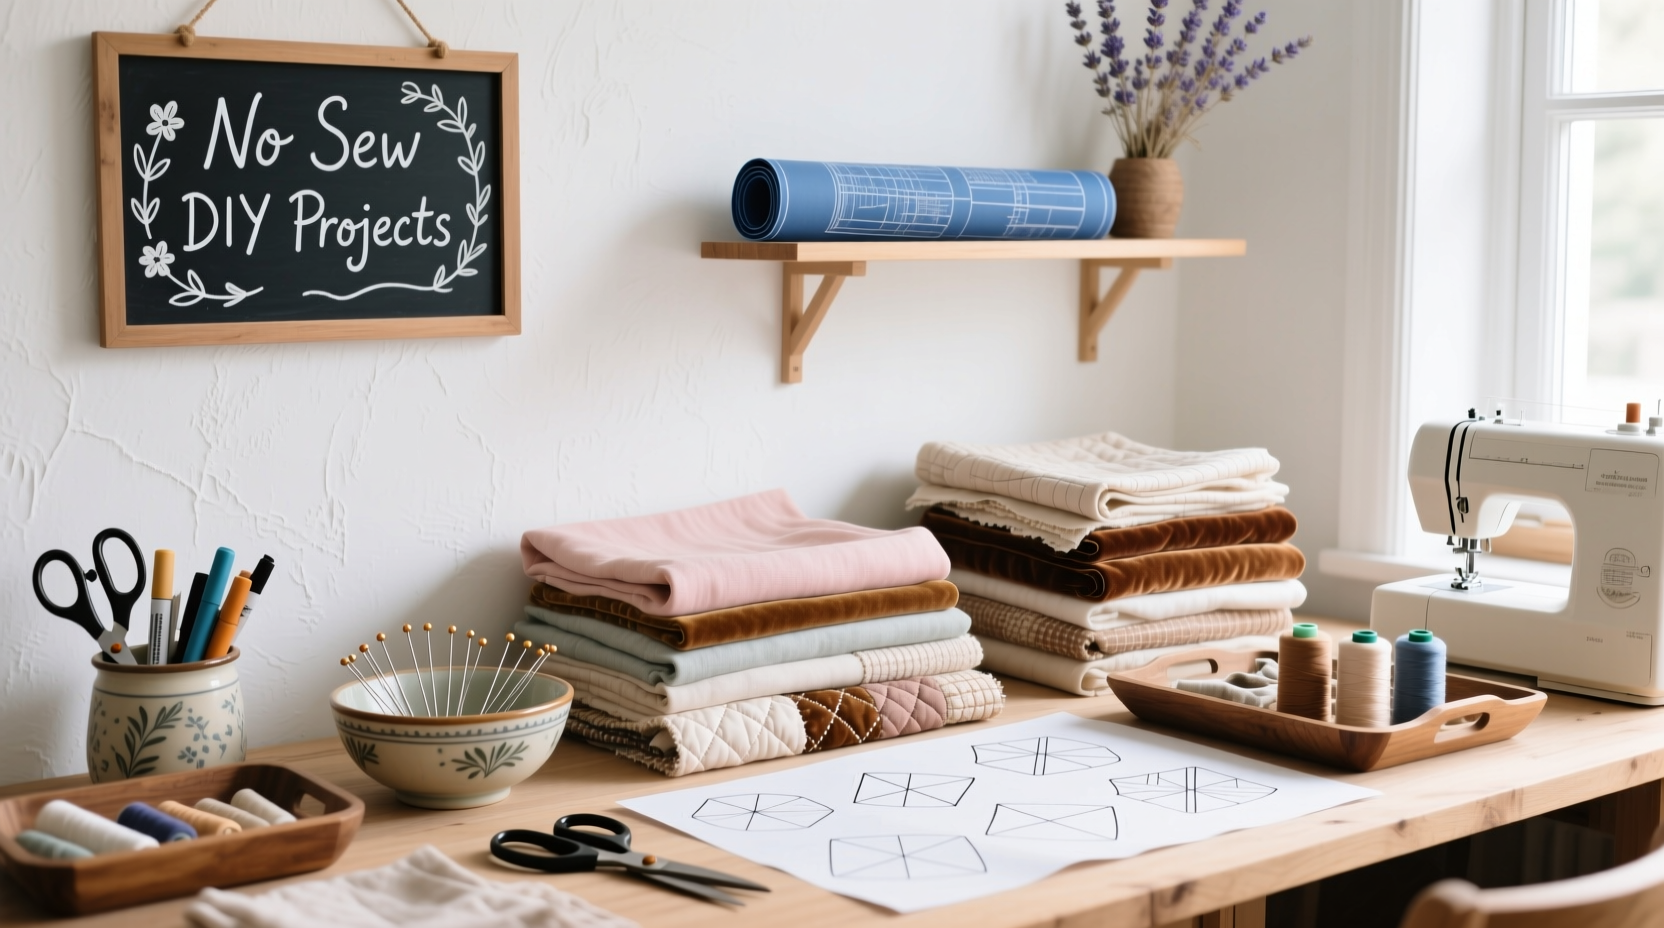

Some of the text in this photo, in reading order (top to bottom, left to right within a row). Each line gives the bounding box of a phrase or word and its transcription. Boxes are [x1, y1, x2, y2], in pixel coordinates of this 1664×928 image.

[204, 92, 421, 171] No Sew
[182, 190, 452, 272] DIY Projects
